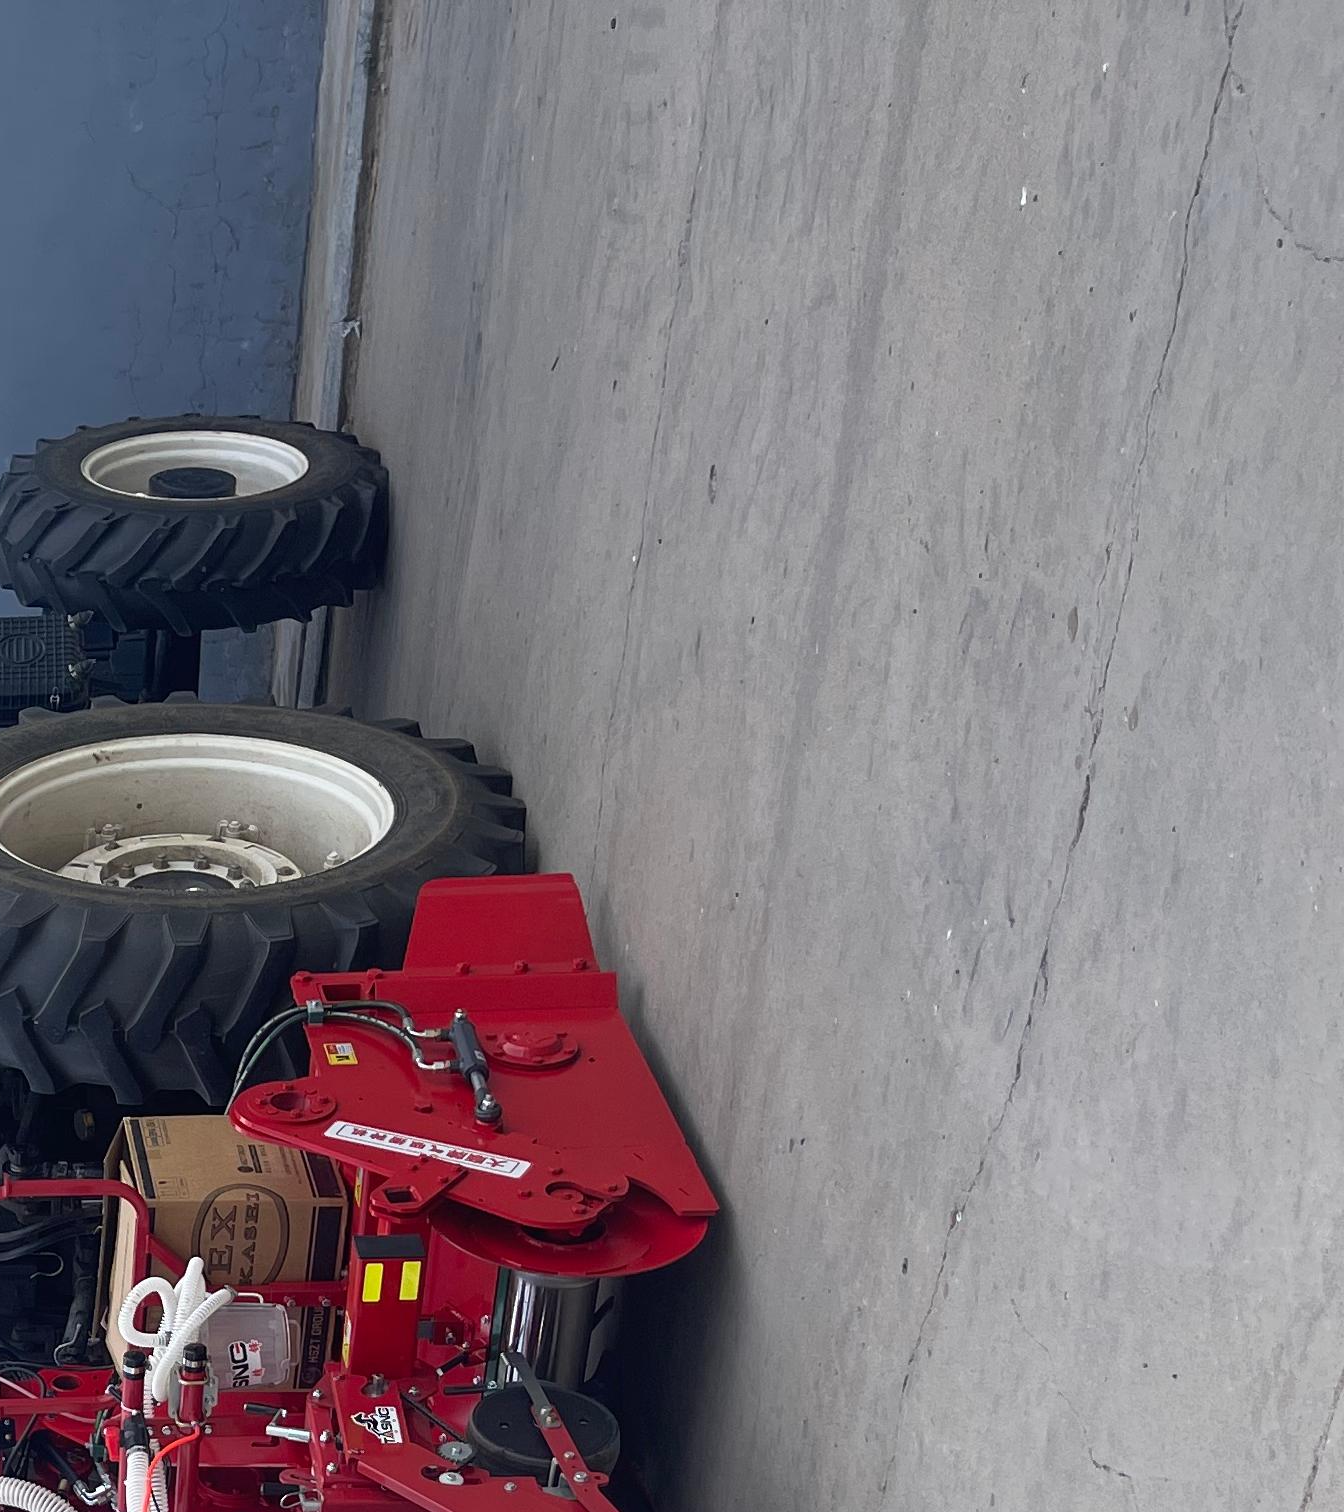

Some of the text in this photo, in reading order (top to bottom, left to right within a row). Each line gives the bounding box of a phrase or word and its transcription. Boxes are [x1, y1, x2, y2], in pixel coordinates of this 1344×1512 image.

[207, 1206, 237, 1275] EX
[311, 1307, 324, 1336] GROU
[378, 1408, 395, 1443] TASNG
